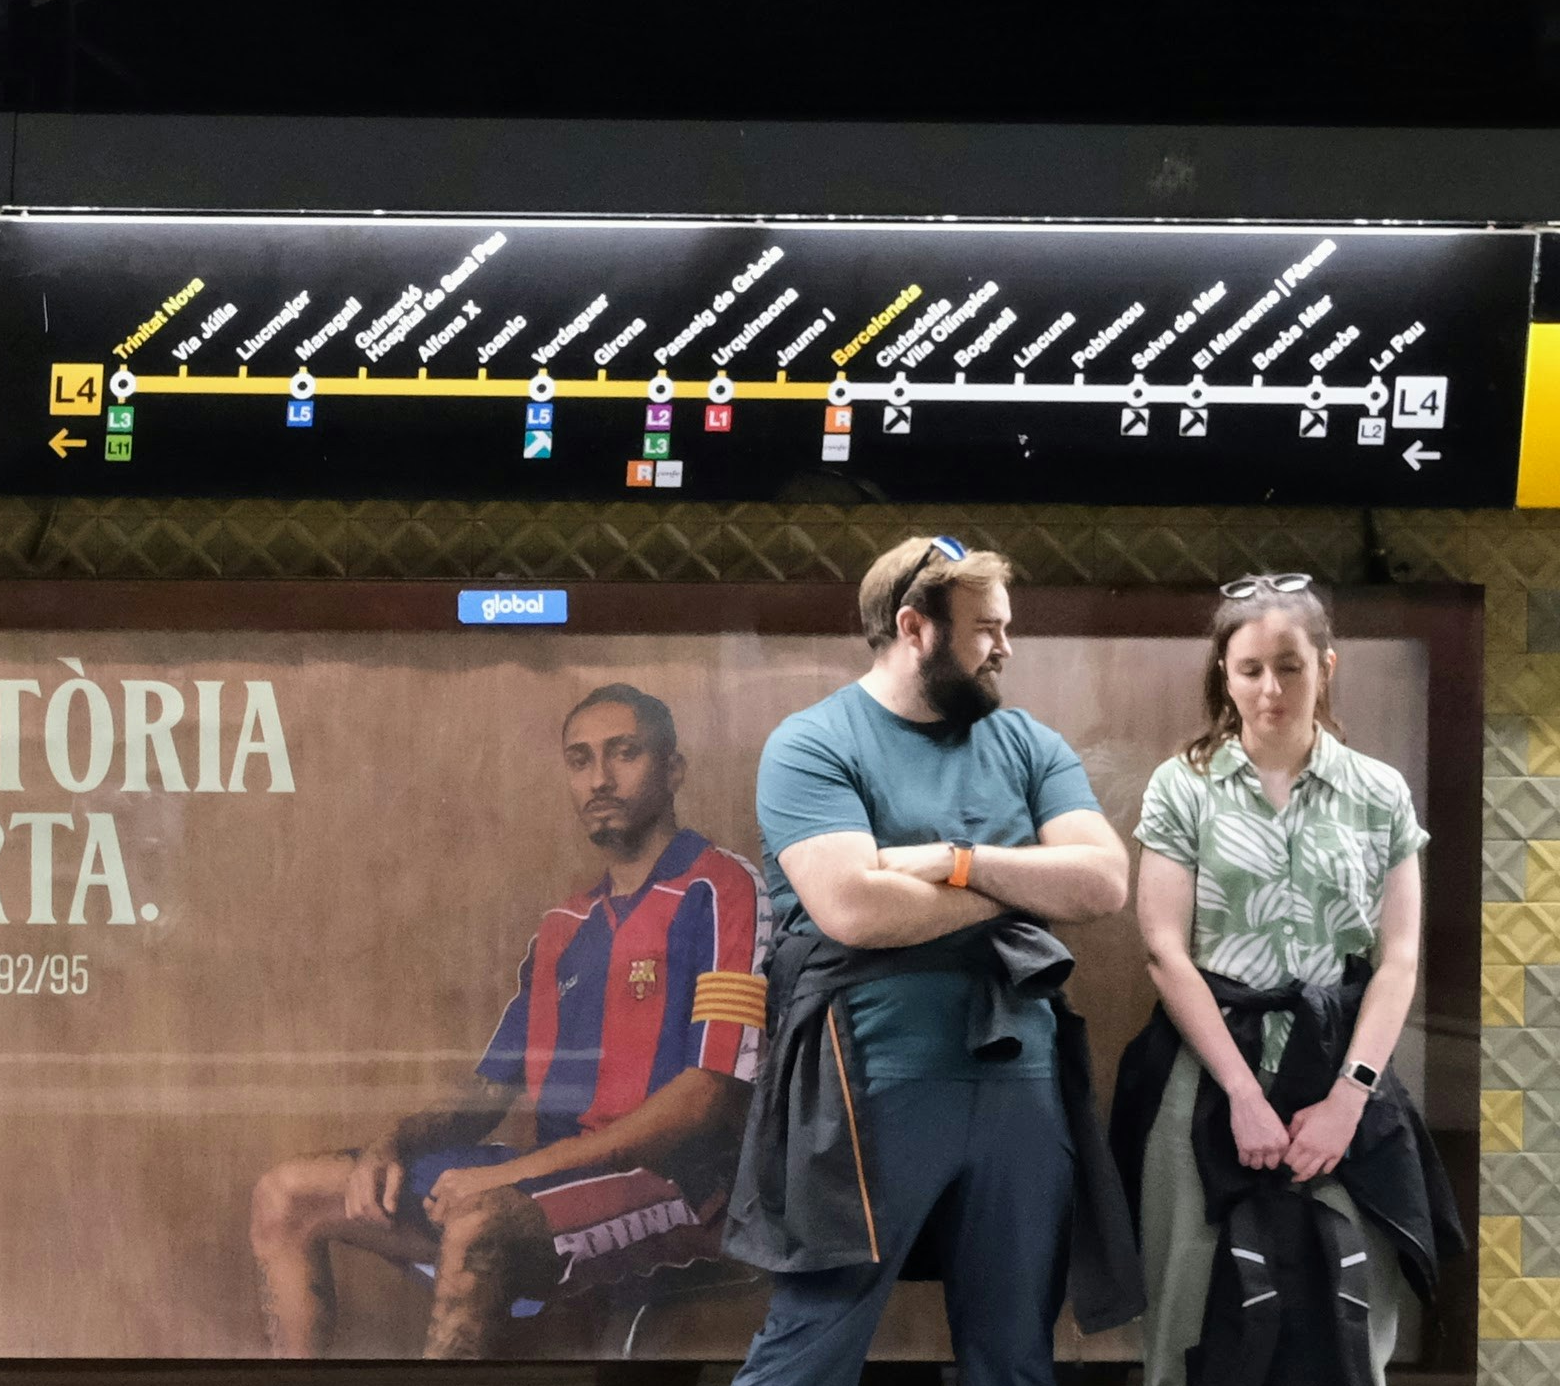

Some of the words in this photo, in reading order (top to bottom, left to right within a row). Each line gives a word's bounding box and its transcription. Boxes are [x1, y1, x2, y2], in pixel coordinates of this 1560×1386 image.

[112, 310, 168, 359] Trinitat
[162, 277, 205, 315] Nova
[235, 290, 312, 361] Llucmajor
[294, 296, 363, 361] Maragall
[354, 284, 423, 349] Guinardó
[365, 304, 426, 363] Hospital
[423, 288, 445, 311] de
[418, 315, 467, 363] Alfons
[461, 299, 482, 321] X
[477, 315, 527, 364] Joanic
[531, 293, 609, 365] Verdaguer
[593, 317, 647, 365] Girona
[653, 308, 717, 365] Passeig
[713, 290, 735, 312] de
[711, 287, 799, 366] Urquinaona
[831, 284, 923, 367] Barceloneta
[876, 298, 952, 368] Ciutadella
[953, 307, 1017, 368] Bogatell
[1013, 312, 1076, 368] Llacuna
[1071, 301, 1145, 369] Poblenou
[1131, 330, 1176, 370] Selva
[1174, 311, 1197, 333] de
[171, 337, 202, 361] Via
[777, 319, 827, 367] Jaume
[900, 340, 935, 368] Vila
[1191, 348, 1214, 370] El
[1369, 349, 1395, 372] La
[1390, 321, 1426, 353] Pau
[55, 376, 97, 404] L4
[288, 406, 311, 421] L5
[1400, 389, 1439, 416] L4
[107, 412, 131, 428] L3
[527, 408, 550, 424] L5
[647, 411, 670, 426] L2
[708, 412, 728, 426] L1
[1361, 424, 1382, 439] L2
[107, 441, 130, 455] L11
[644, 438, 668, 453] L3
[481, 593, 544, 621] global
